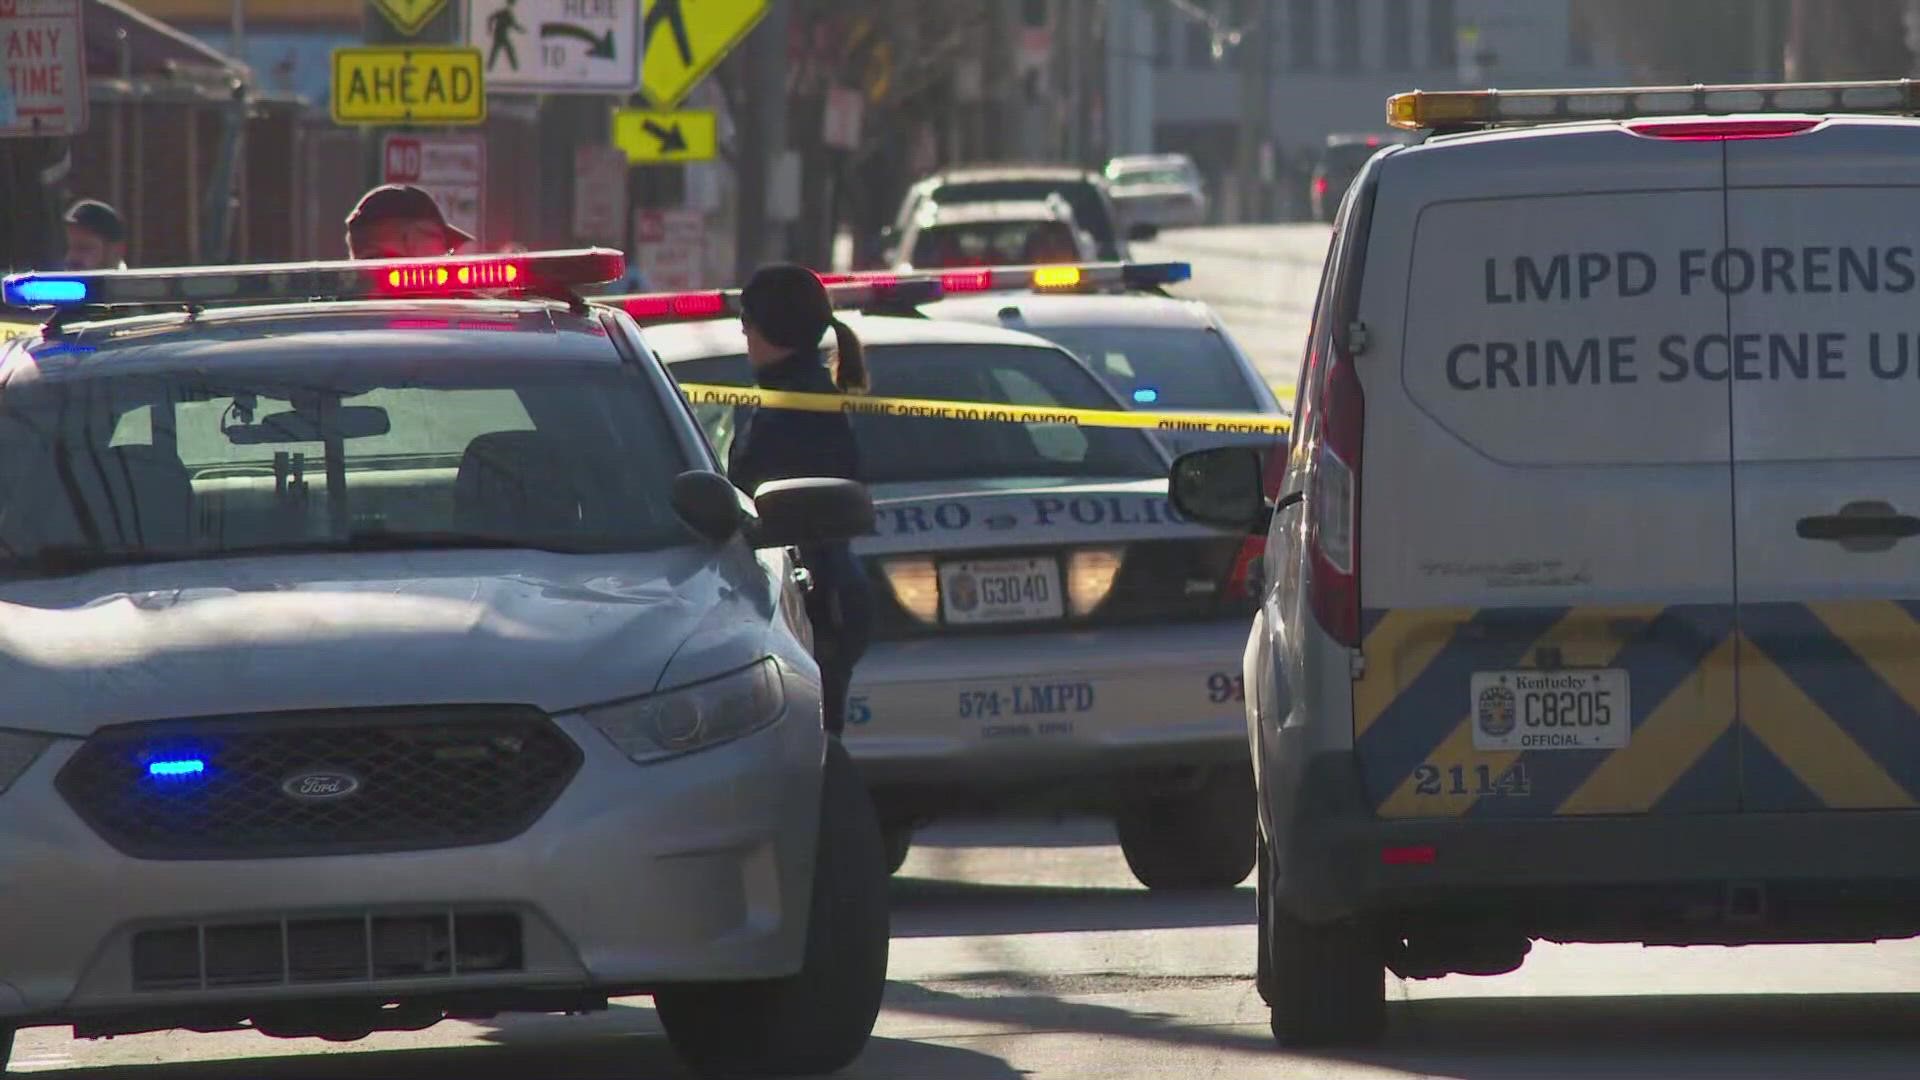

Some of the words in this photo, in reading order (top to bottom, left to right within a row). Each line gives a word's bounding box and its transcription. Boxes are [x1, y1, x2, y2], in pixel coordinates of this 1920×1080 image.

[7, 28, 61, 58] ANY
[541, 45, 566, 66] TO
[7, 64, 64, 96] TIME
[348, 65, 473, 104] AHEAD
[1485, 251, 1657, 304] LMPD
[1680, 246, 1915, 296] FORENS
[1446, 336, 1638, 390] CRIME
[1658, 332, 1846, 382] SCENE
[1869, 332, 1920, 380] U
[982, 575, 1049, 605] G3040
[1516, 675, 1586, 690] Kentucky
[959, 682, 1095, 719] 574-LMPD
[1525, 691, 1611, 727] C8205
[1521, 734, 1582, 746] OFFICIAL
[301, 776, 341, 793] Ford
[1414, 763, 1530, 796] 2114
